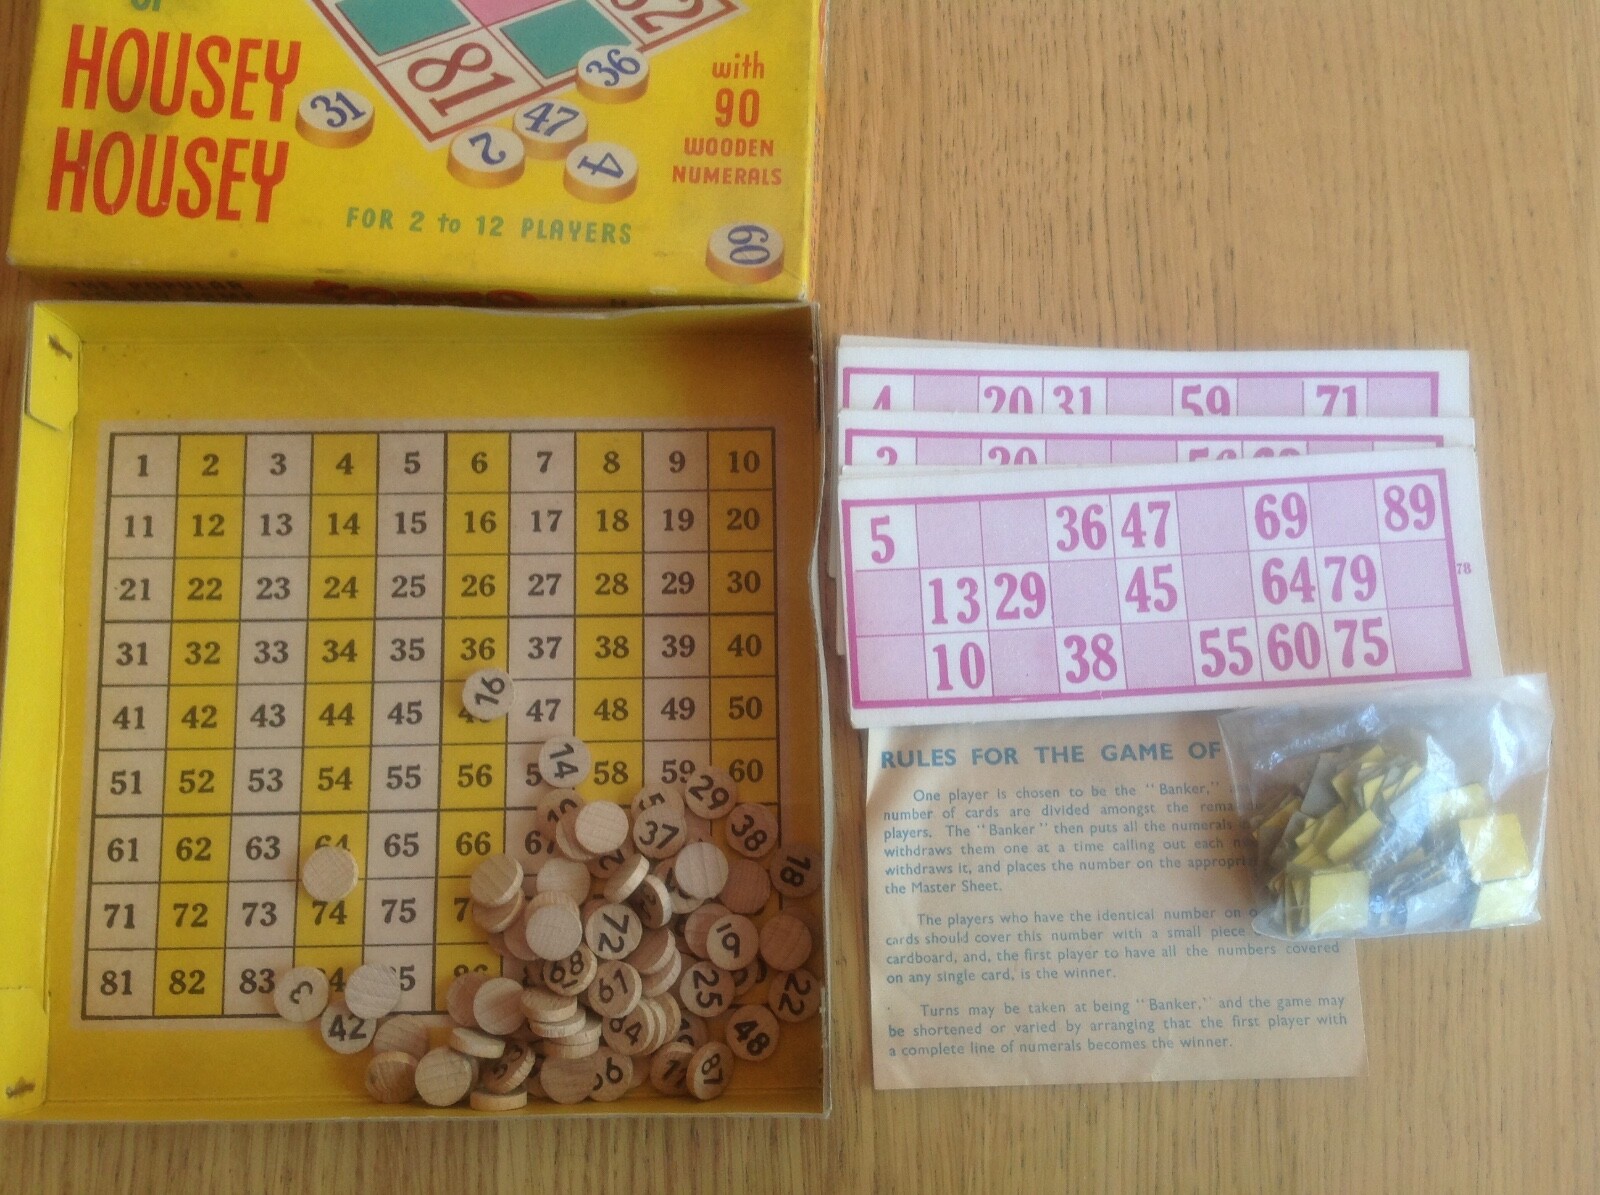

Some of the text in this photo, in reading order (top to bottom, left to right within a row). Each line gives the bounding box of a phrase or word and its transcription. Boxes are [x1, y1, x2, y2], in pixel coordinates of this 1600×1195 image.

[61, 24, 301, 122] HOUSEY
[407, 42, 514, 117] 81
[586, 49, 640, 86] 36
[712, 51, 764, 79] with
[310, 91, 365, 127] 31
[523, 102, 579, 136] 47
[715, 88, 760, 127] 90
[469, 132, 506, 165] 2
[684, 137, 774, 157] WOODEN
[47, 126, 289, 223] HOUSEY
[578, 152, 623, 178] 4
[672, 166, 782, 185] NUMERALS
[346, 206, 632, 245] FOR 2 to 12 PLAYERS
[1316, 386, 1358, 416] 71
[137, 451, 760, 476] 1 2 3 4 5 6 7 8 9 10
[871, 483, 1436, 563] 5 36 47 69 89
[1456, 561, 1472, 575] 78
[119, 571, 760, 601] 21 22 23 24 25 26 27 28 29 30
[929, 554, 1377, 625] 13 29 45 64 79
[933, 617, 1389, 691] 10 38 55 60 75
[549, 743, 579, 779] 14
[881, 742, 1221, 768] RULES FOR THE GAME OF
[110, 764, 492, 794] 51 52 53 54 55 56
[593, 759, 763, 784] 58 60
[689, 775, 729, 810] 29
[913, 790, 940, 802] One
[949, 788, 988, 804] player
[998, 788, 1006, 799] is
[1016, 787, 1059, 799] chosen
[1070, 787, 1083, 797] to
[1092, 786, 1106, 797] be
[1115, 786, 1136, 796] the
[640, 821, 679, 849] 37
[731, 815, 767, 850] 38
[884, 829, 932, 842] players.
[946, 825, 970, 836] The
[1054, 823, 1083, 834] then
[1091, 820, 1117, 836] puts
[1124, 821, 1138, 832] all
[1145, 820, 1165, 831] the
[1172, 819, 1232, 831] numerals
[104, 898, 416, 929] 71 72 73 74 75
[918, 908, 1241, 928] The players who have the identical number on
[599, 913, 630, 952] 72
[887, 942, 1340, 964] cardboard, and, the first player to have all the numbers covered
[100, 970, 205, 995] 81 82
[692, 970, 722, 1008] 25
[328, 1014, 366, 1041] 42
[735, 1020, 770, 1056] 48
[889, 1012, 1347, 1038] be shortened or varied by arranging that the first player with
[889, 1037, 1232, 1057] a complete line of numerals becomes the winner.
